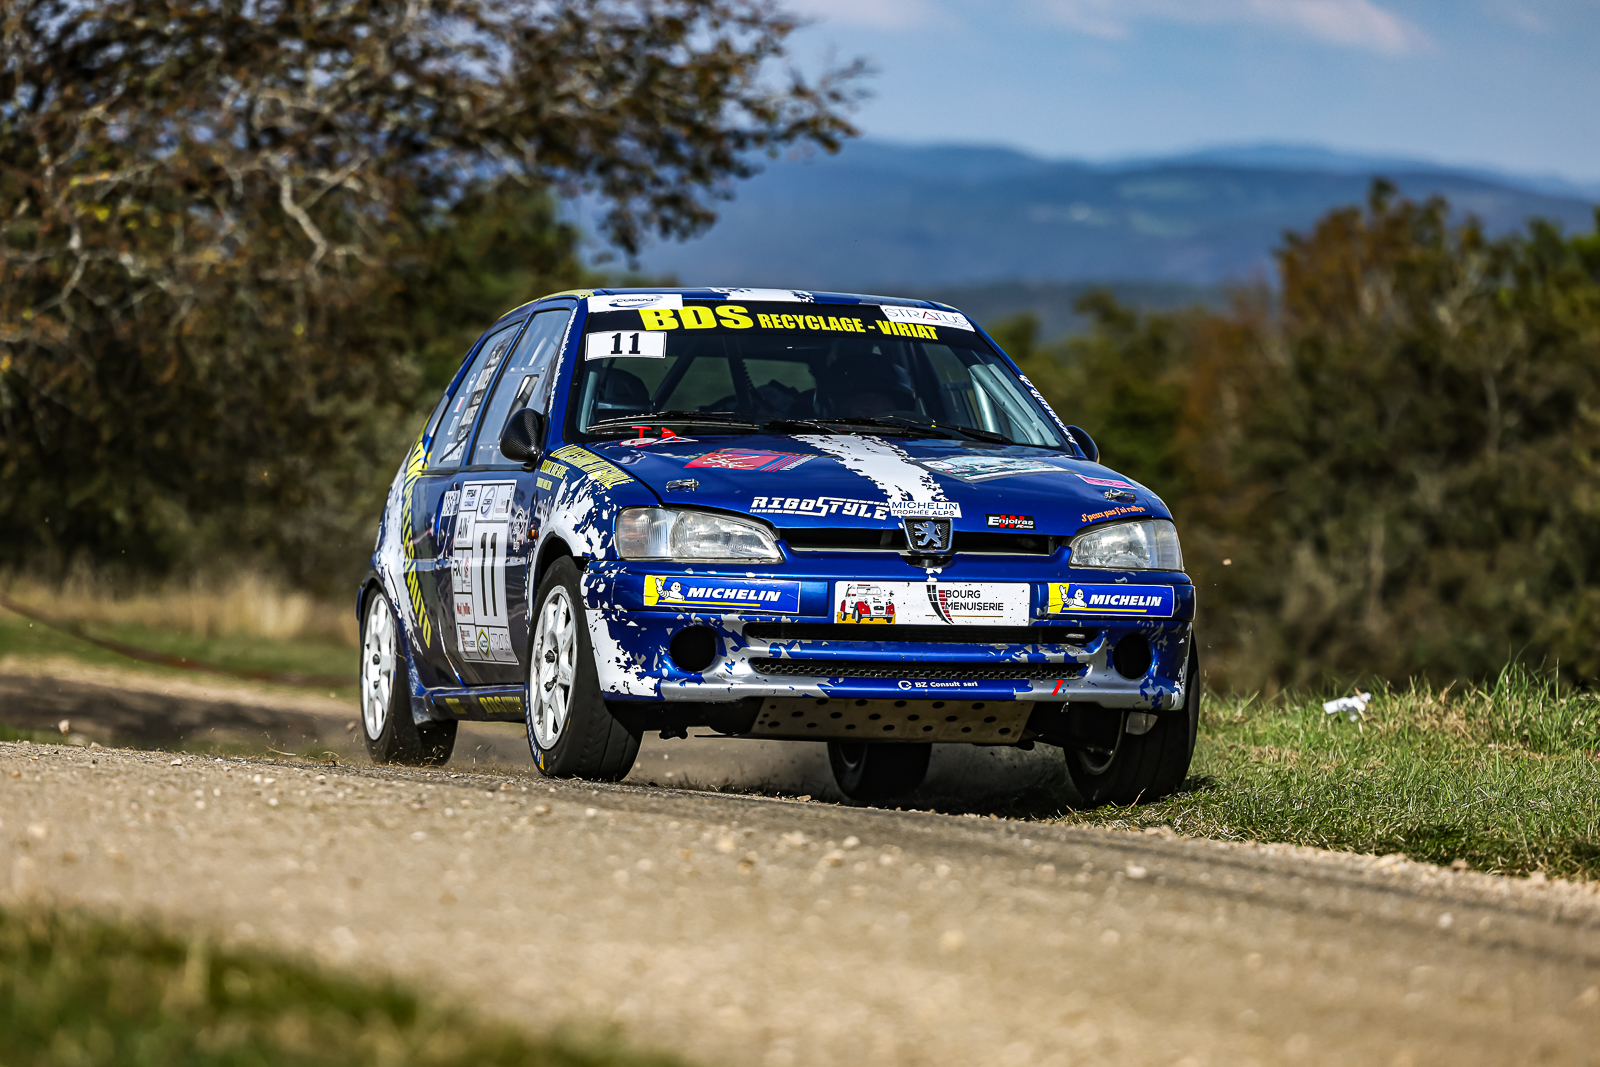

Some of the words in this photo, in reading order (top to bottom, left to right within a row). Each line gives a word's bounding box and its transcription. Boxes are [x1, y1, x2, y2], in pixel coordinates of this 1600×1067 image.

[638, 305, 754, 331] BDS
[757, 313, 867, 333] RECYCLAGE
[875, 319, 939, 340] VIRIAT
[610, 332, 641, 355] 11
[891, 501, 958, 510] MICHELIN
[1104, 509, 1118, 518] pas
[1126, 505, 1146, 513] rallye
[987, 516, 1034, 526] Enjolras
[480, 532, 498, 617] 11
[686, 587, 782, 603] MICHELIN
[945, 589, 981, 599] BOURG
[944, 601, 1004, 611] MENUISERIE
[1089, 594, 1163, 608] MICHELIN
